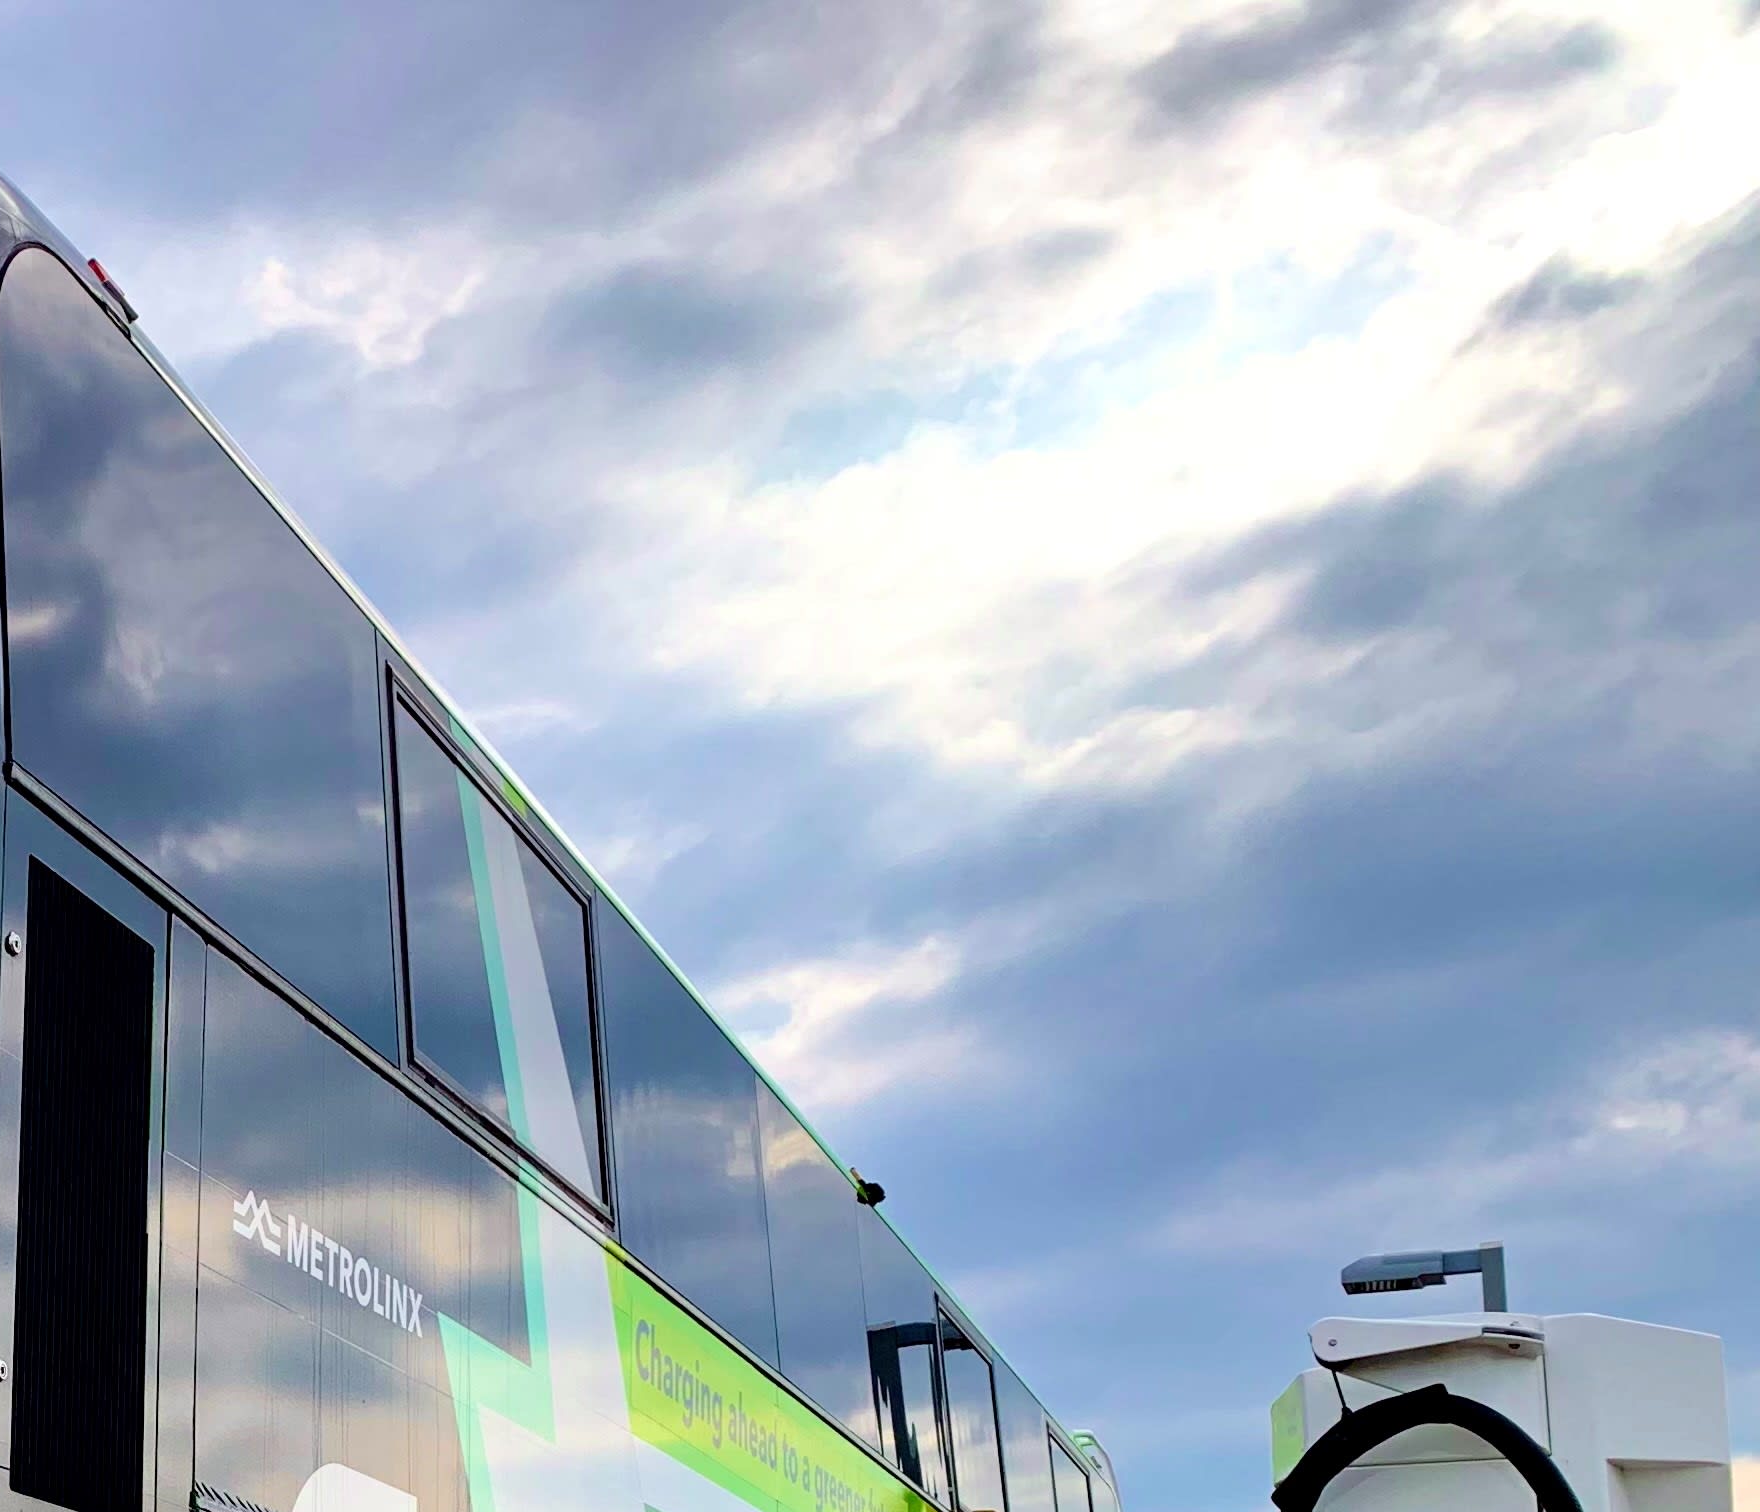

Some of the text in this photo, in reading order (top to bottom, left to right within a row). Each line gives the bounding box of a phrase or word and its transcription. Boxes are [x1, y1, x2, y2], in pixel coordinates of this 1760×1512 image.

[286, 1213, 424, 1339] METROLINX
[635, 1318, 723, 1449] Charging
[728, 1391, 778, 1472] ahead
[782, 1433, 799, 1485] to
[802, 1456, 810, 1492] a
